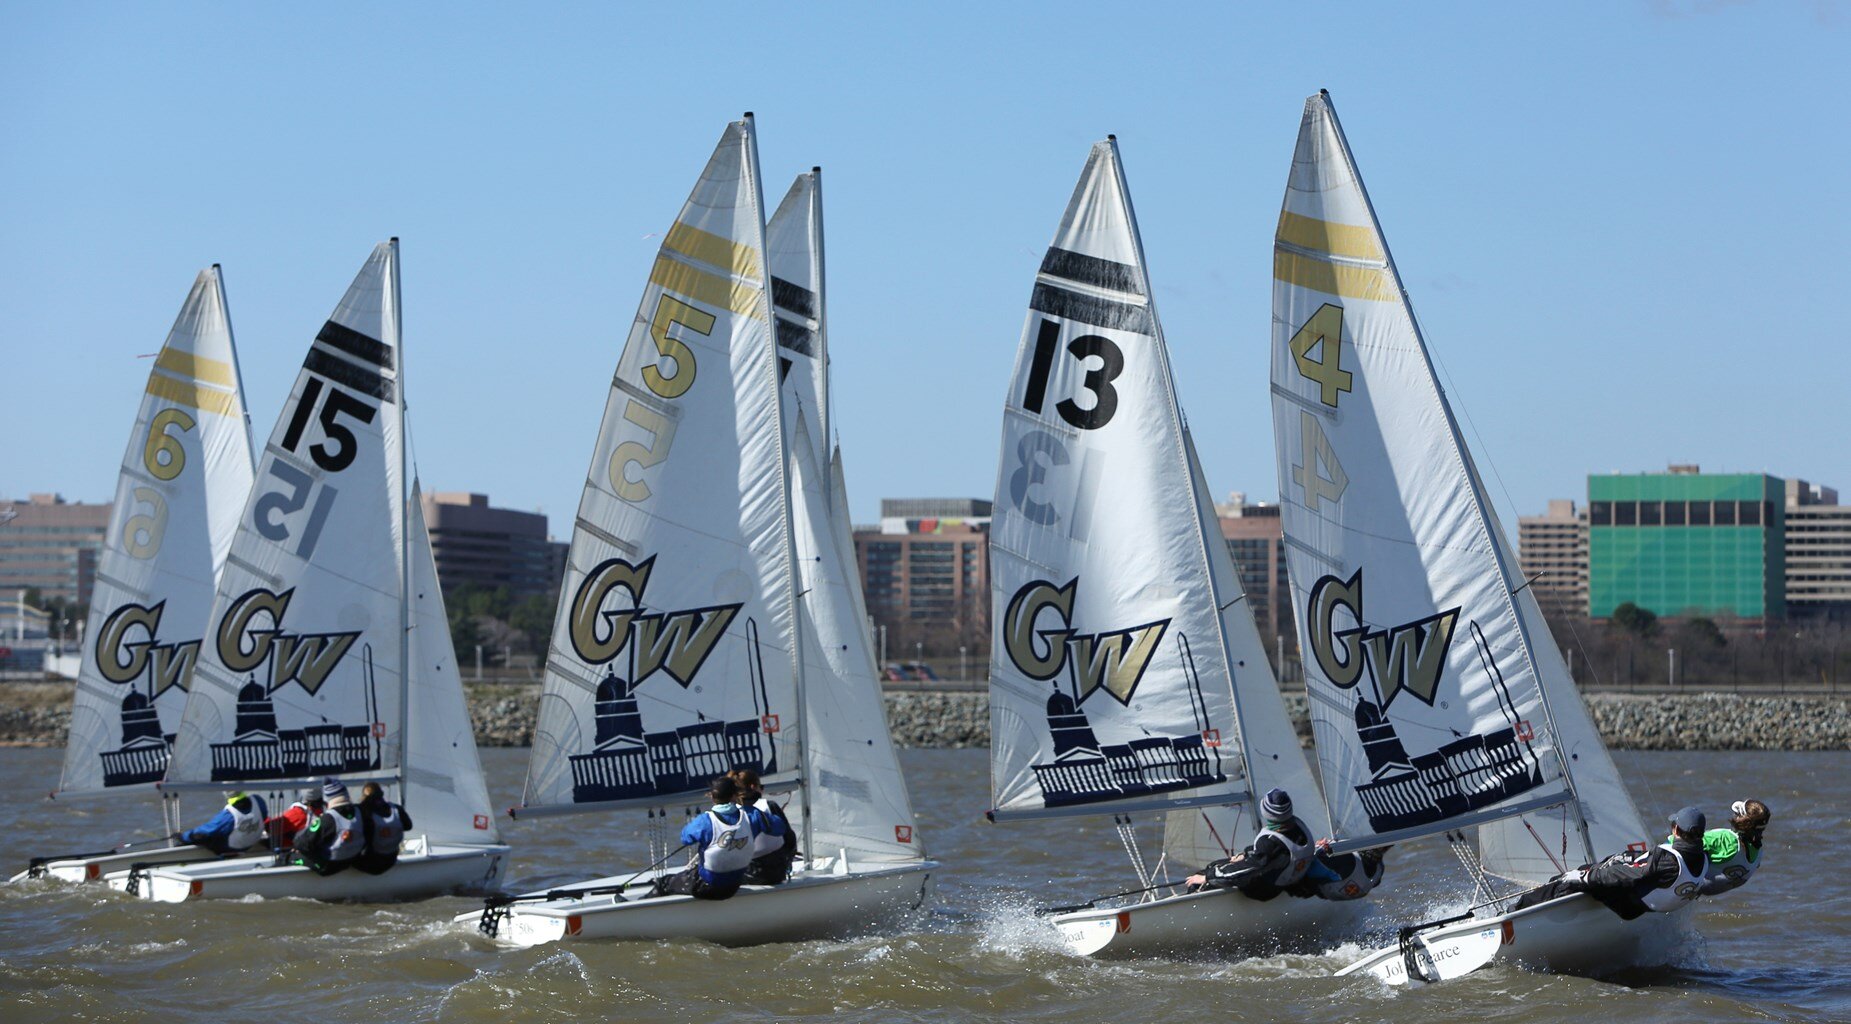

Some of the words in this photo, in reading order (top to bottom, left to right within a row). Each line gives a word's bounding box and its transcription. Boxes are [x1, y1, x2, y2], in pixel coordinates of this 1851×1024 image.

[641, 293, 716, 398] 5
[1023, 318, 1124, 430] 13
[1289, 302, 1353, 408] 4
[143, 408, 196, 481] 6
[281, 376, 377, 472] 15
[217, 586, 364, 696] GW
[569, 553, 745, 693] GW
[1003, 576, 1173, 709] GW
[1307, 567, 1462, 720] GW
[1417, 945, 1461, 967] Pearce
